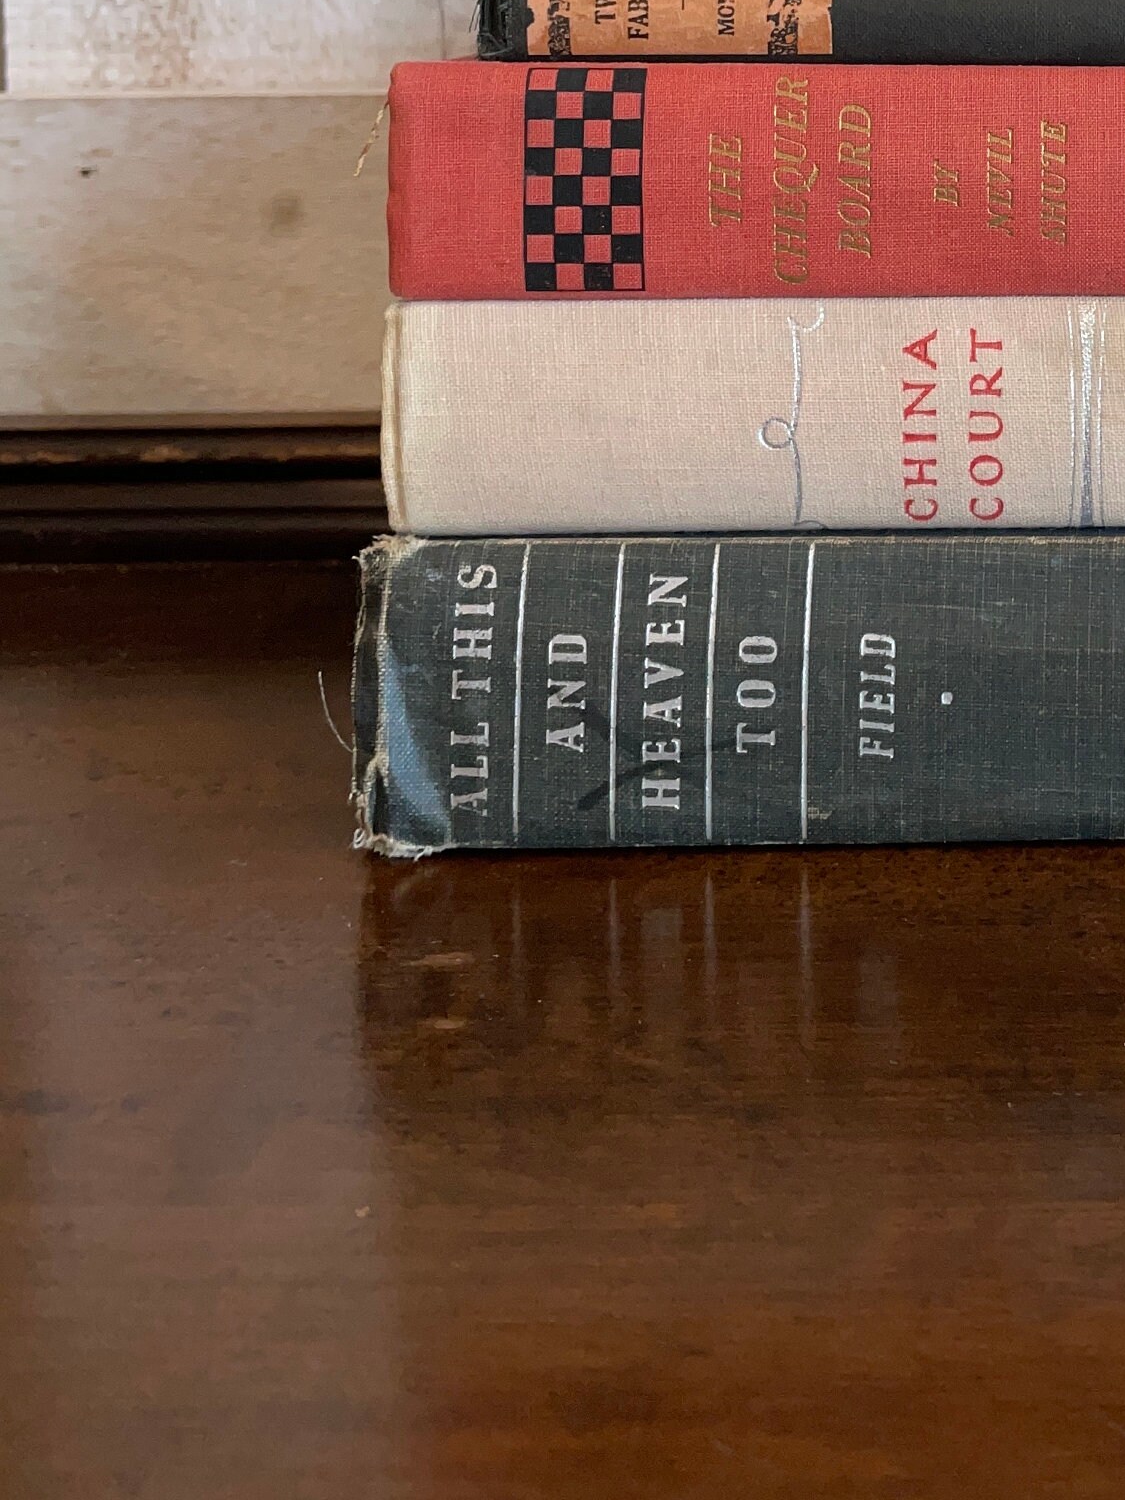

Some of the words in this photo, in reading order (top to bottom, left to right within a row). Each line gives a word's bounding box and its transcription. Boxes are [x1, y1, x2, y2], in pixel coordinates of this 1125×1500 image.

[708, 132, 743, 228] THE
[773, 75, 820, 284] CHEQUER
[837, 103, 873, 258] BOARD
[933, 159, 960, 207] BY
[986, 128, 1014, 236] NEVIL
[1040, 120, 1069, 246] SHUTE
[902, 328, 938, 522] CHINA
[968, 328, 1004, 521] COURT
[451, 563, 497, 701] THIS
[545, 633, 588, 753] AND
[641, 572, 689, 811] HEAVEN
[736, 634, 778, 754] TOO
[859, 632, 896, 760] FIELD
[450, 721, 490, 817] ALL
